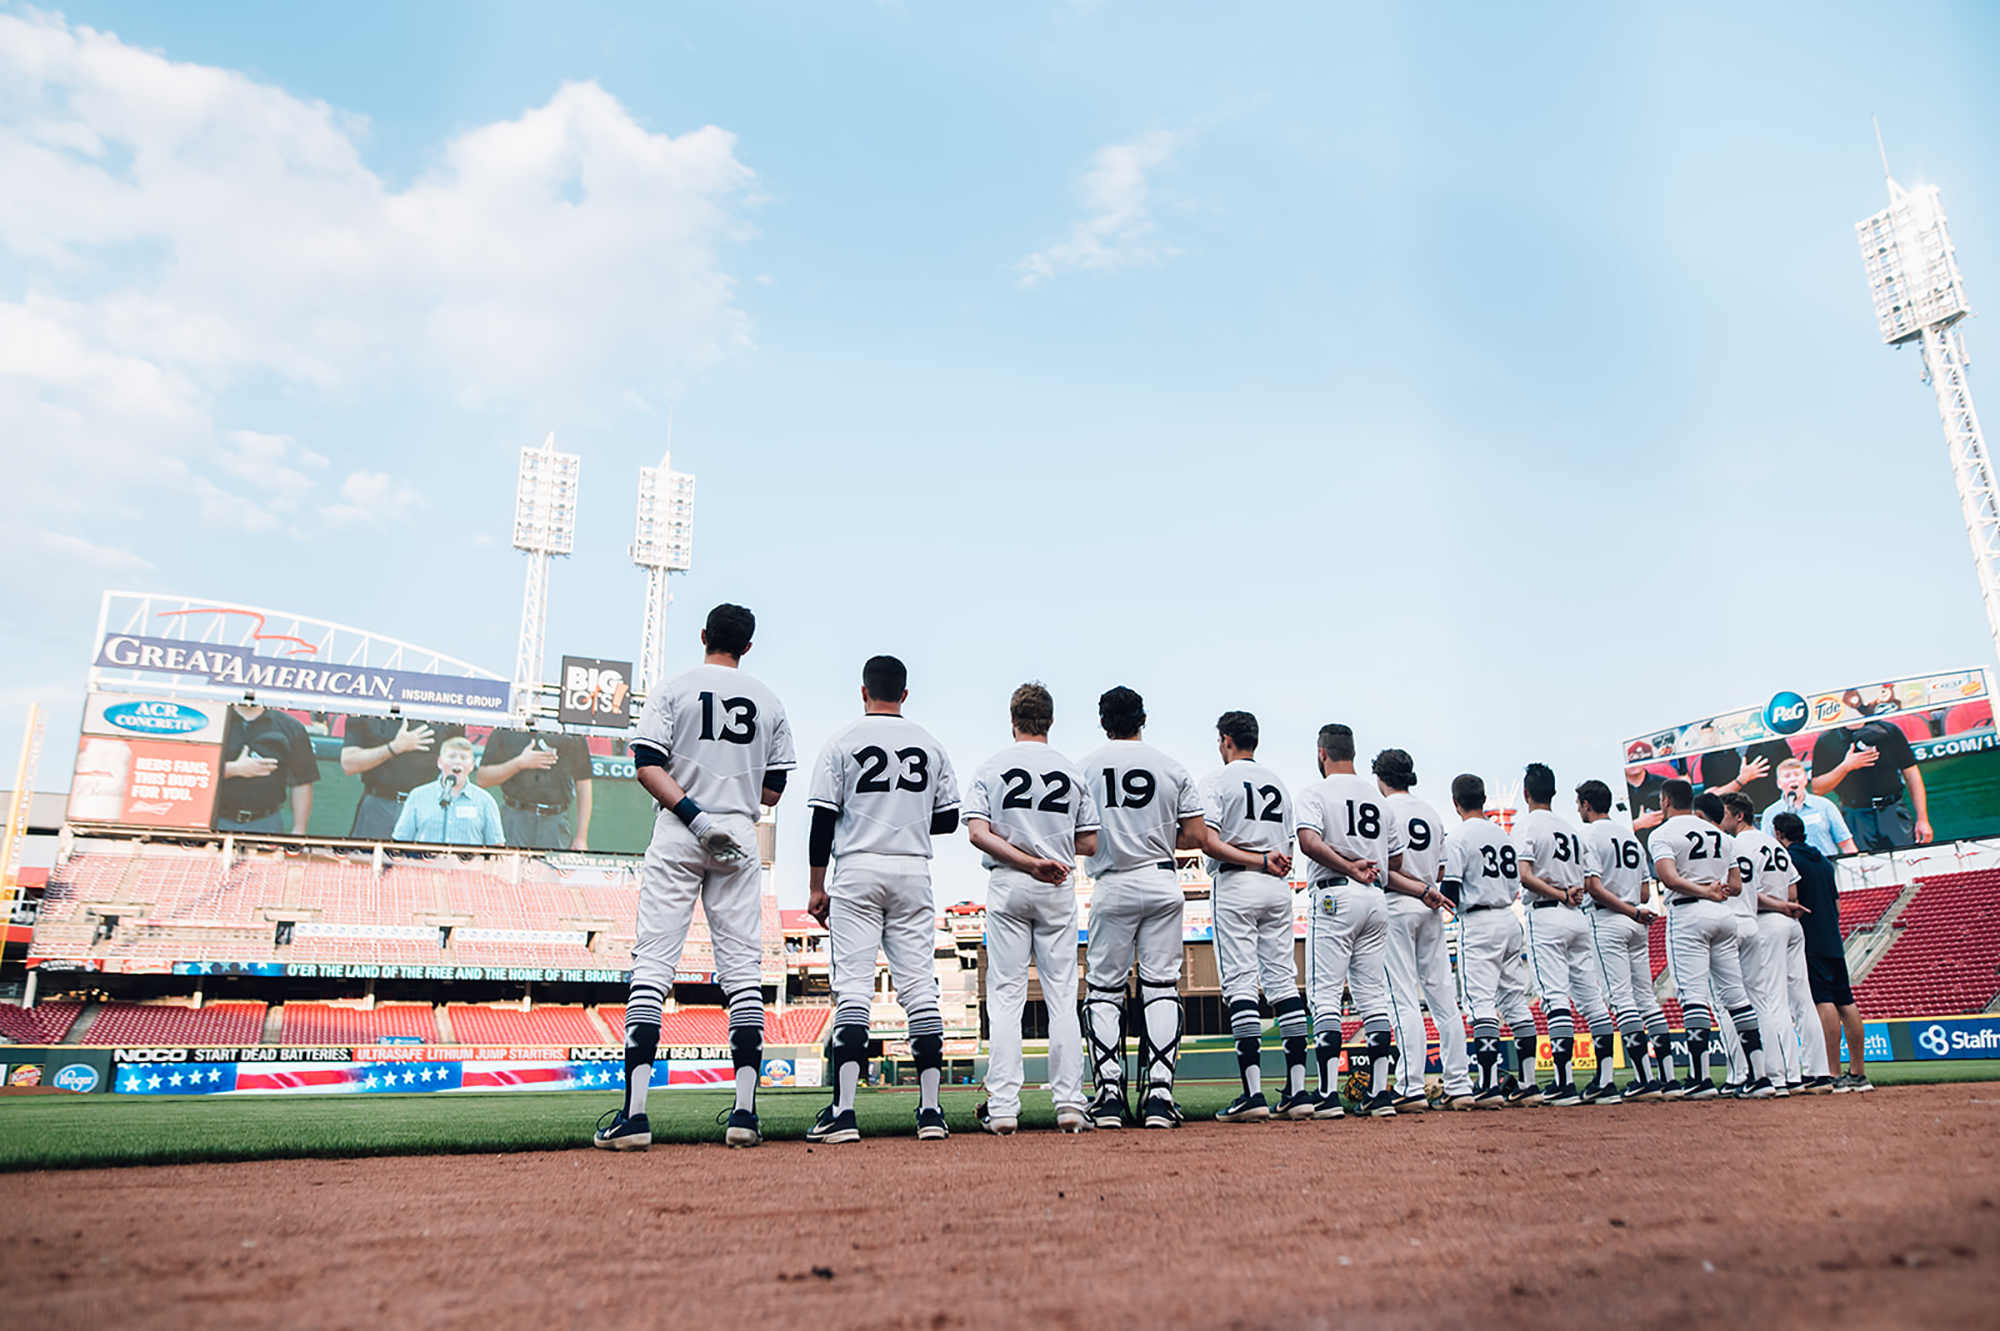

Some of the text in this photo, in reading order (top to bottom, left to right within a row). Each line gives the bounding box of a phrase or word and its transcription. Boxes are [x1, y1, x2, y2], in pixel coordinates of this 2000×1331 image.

[567, 665, 624, 694] BIG
[135, 702, 180, 718] ACR
[402, 689, 503, 708] INSURANCE GROUP
[1814, 700, 1841, 721] Tide
[115, 714, 192, 731] CONCRETE
[698, 691, 757, 744] 13
[1772, 702, 1805, 724] P&G
[136, 757, 172, 772] REDS
[852, 745, 929, 793] 23
[134, 771, 210, 788] THIS BUD'S
[1000, 768, 1071, 814] 22
[1102, 768, 1157, 809] 19
[131, 785, 160, 799] FOR
[161, 787, 193, 801] YOU.
[1243, 781, 1283, 823] 12
[1346, 800, 1380, 839] 18
[1407, 818, 1431, 851] 9
[1685, 831, 1722, 860] 27
[1553, 832, 1580, 865] 31
[1611, 838, 1640, 869] 16
[1760, 845, 1789, 872] 26
[1480, 845, 1518, 879] 38
[286, 963, 622, 983] O'ER THE LAND OF THE FREE AND THE HOME OF THE BRAVE
[114, 1048, 351, 1062] NOCO START DEAD BATTERIES.
[357, 1048, 423, 1061] ULTRASAFE
[427, 1048, 474, 1061] LITHIUM
[475, 1048, 507, 1061] JUMP
[670, 1048, 701, 1059] DEAD
[59, 1070, 94, 1091] Kroger
